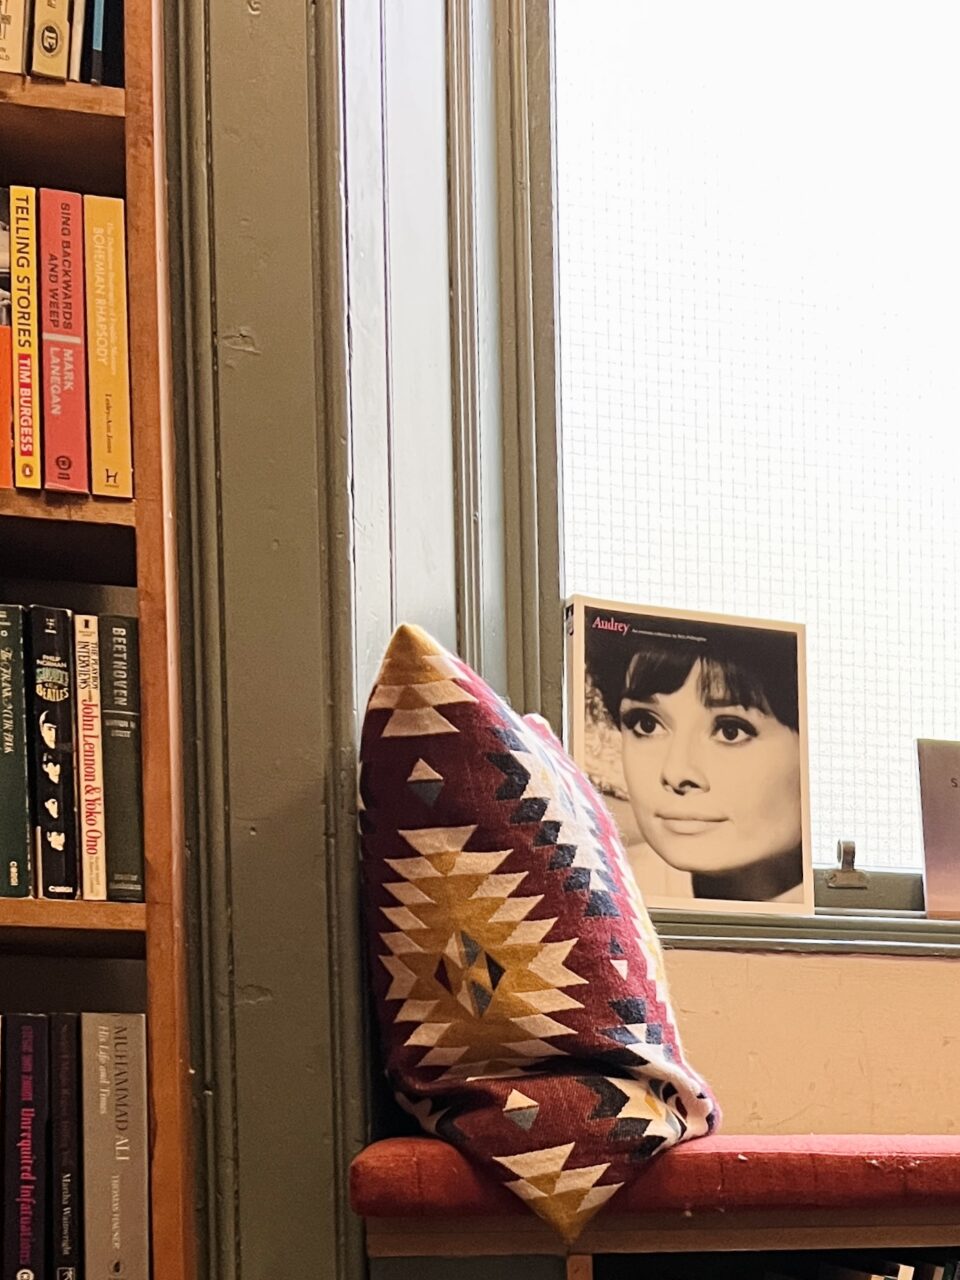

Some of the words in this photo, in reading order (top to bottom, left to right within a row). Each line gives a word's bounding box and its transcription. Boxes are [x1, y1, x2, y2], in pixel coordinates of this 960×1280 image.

[16, 196, 31, 271] TELLING
[60, 203, 71, 236] SING
[48, 253, 59, 283] AND
[93, 227, 106, 294] BOHEMIAN
[62, 240, 73, 329] BACKWARDS
[17, 275, 31, 347] STORIES
[49, 287, 60, 328] WEEP
[95, 298, 108, 366] RHAPSODY
[19, 358, 31, 384] TIM
[49, 347, 61, 414] LANEGAN
[63, 349, 74, 390] MARK
[20, 388, 32, 452] BURGESS
[592, 616, 630, 636] Audrey
[78, 641, 90, 690] INTERVIEWS
[112, 627, 127, 706] BEETHOVEN
[81, 700, 98, 731] John
[83, 734, 100, 781] Lennon
[84, 785, 100, 795] &
[85, 798, 102, 826] Yoko
[86, 829, 103, 855] Ono
[114, 1025, 129, 1131] MUHAMMAD
[115, 1135, 129, 1161] ALI
